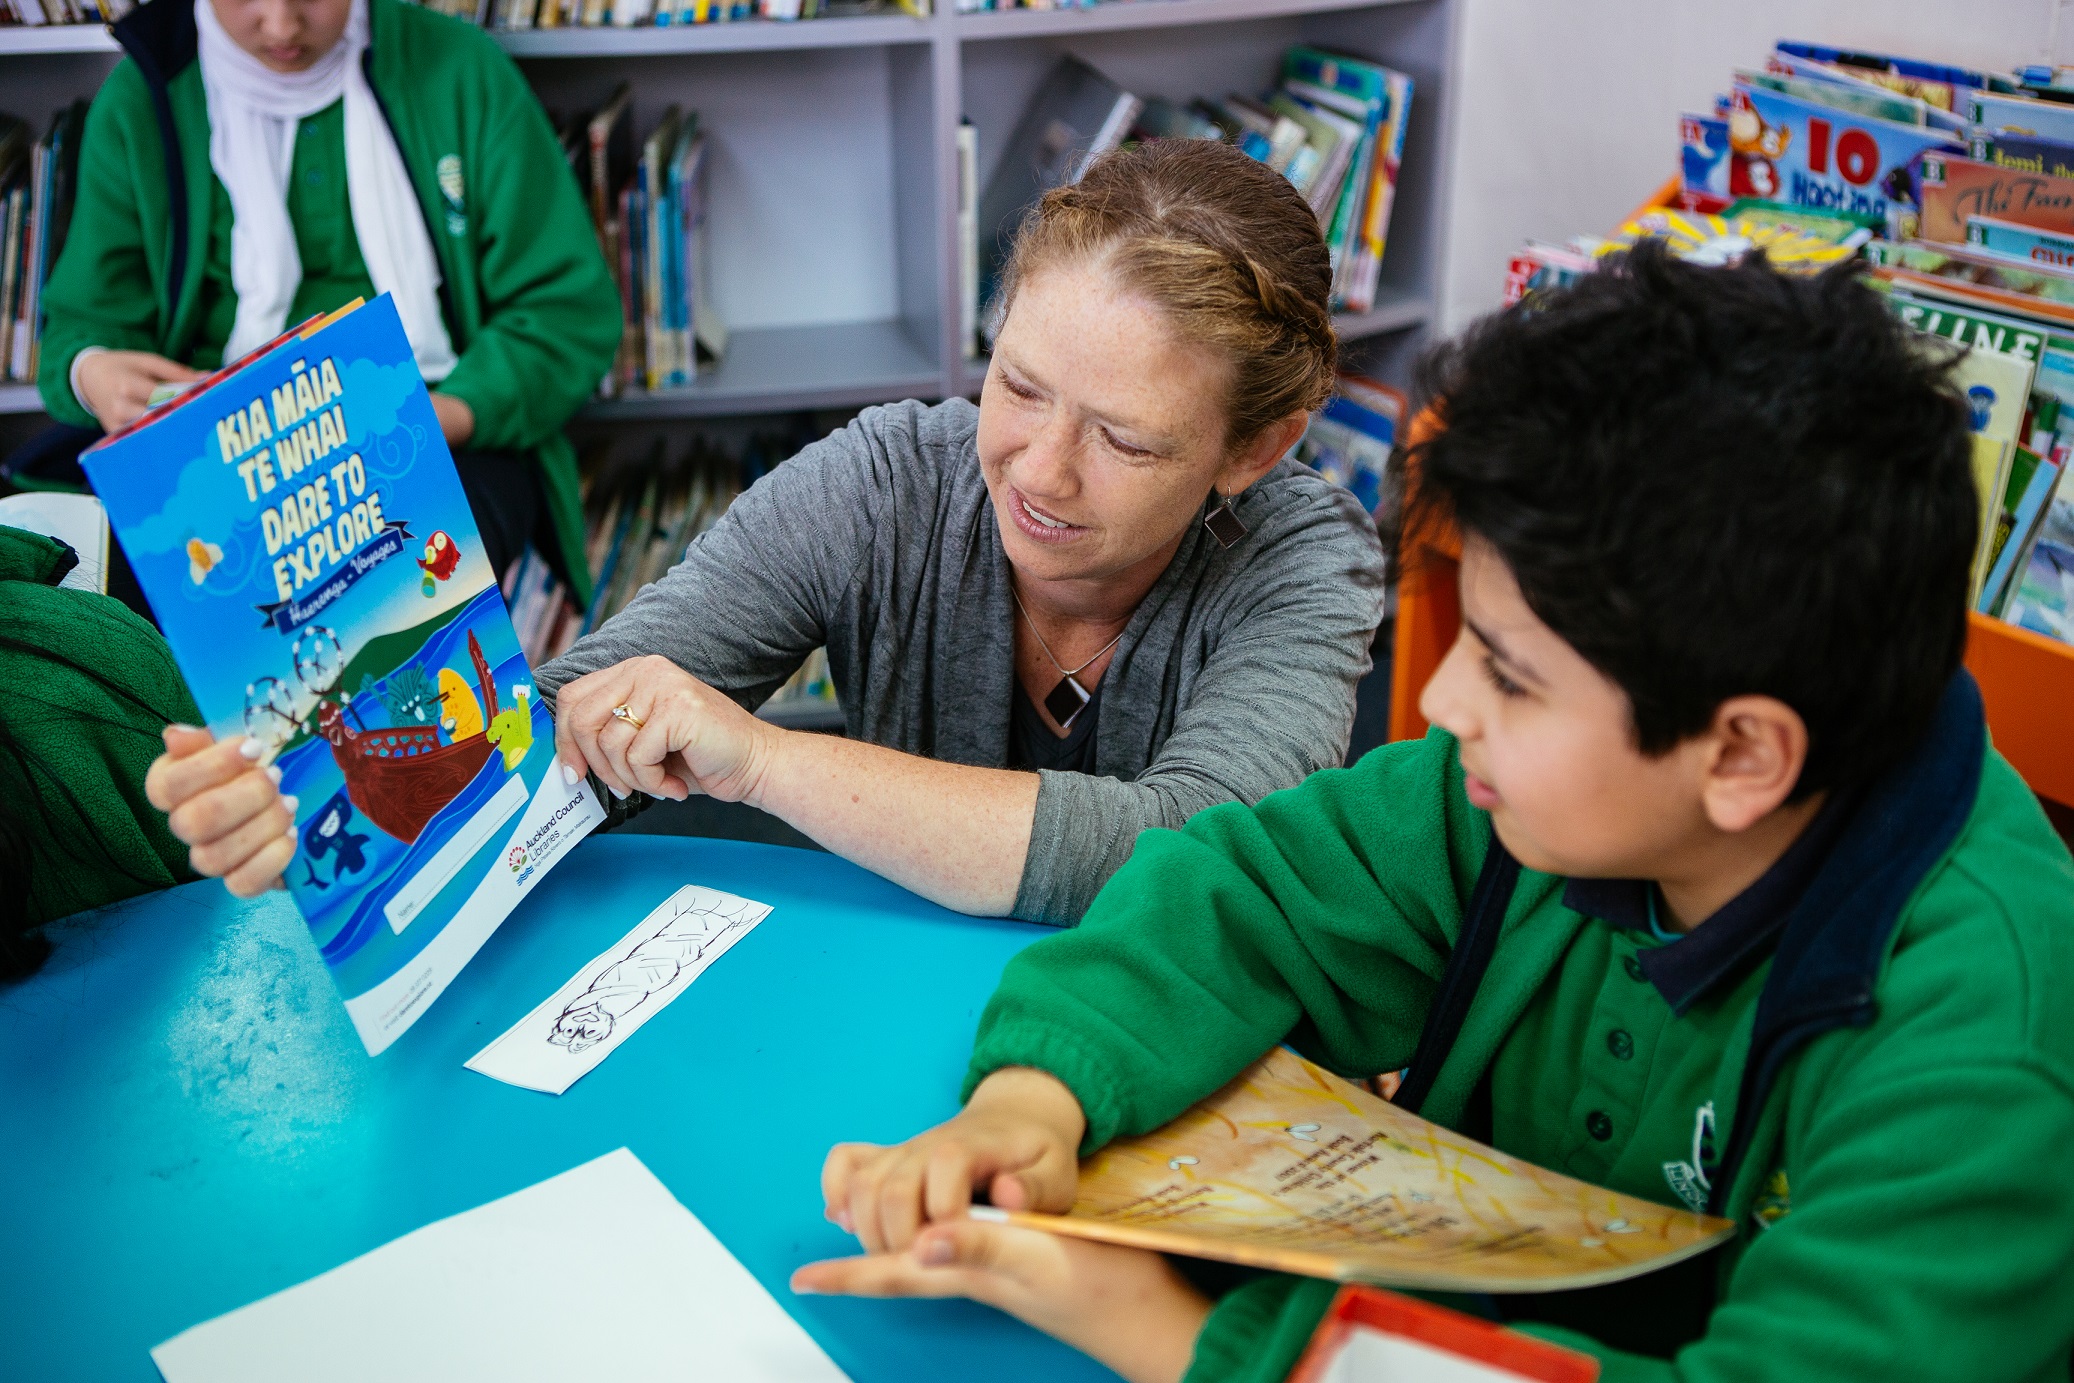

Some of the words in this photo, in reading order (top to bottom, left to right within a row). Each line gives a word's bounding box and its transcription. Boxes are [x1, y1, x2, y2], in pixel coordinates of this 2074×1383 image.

[1808, 116, 1880, 186] 10
[216, 396, 273, 465] KIA
[271, 356, 343, 432] MĀIA
[237, 447, 277, 503] TE
[274, 402, 348, 481] WHAI
[261, 474, 332, 556] DARE
[330, 453, 366, 507] TO
[273, 490, 386, 602] EXPLORE
[350, 540, 398, 574] Voyages
[525, 815, 557, 850] Auckland
[555, 791, 585, 820] Council
[528, 830, 561, 862] Libraries
